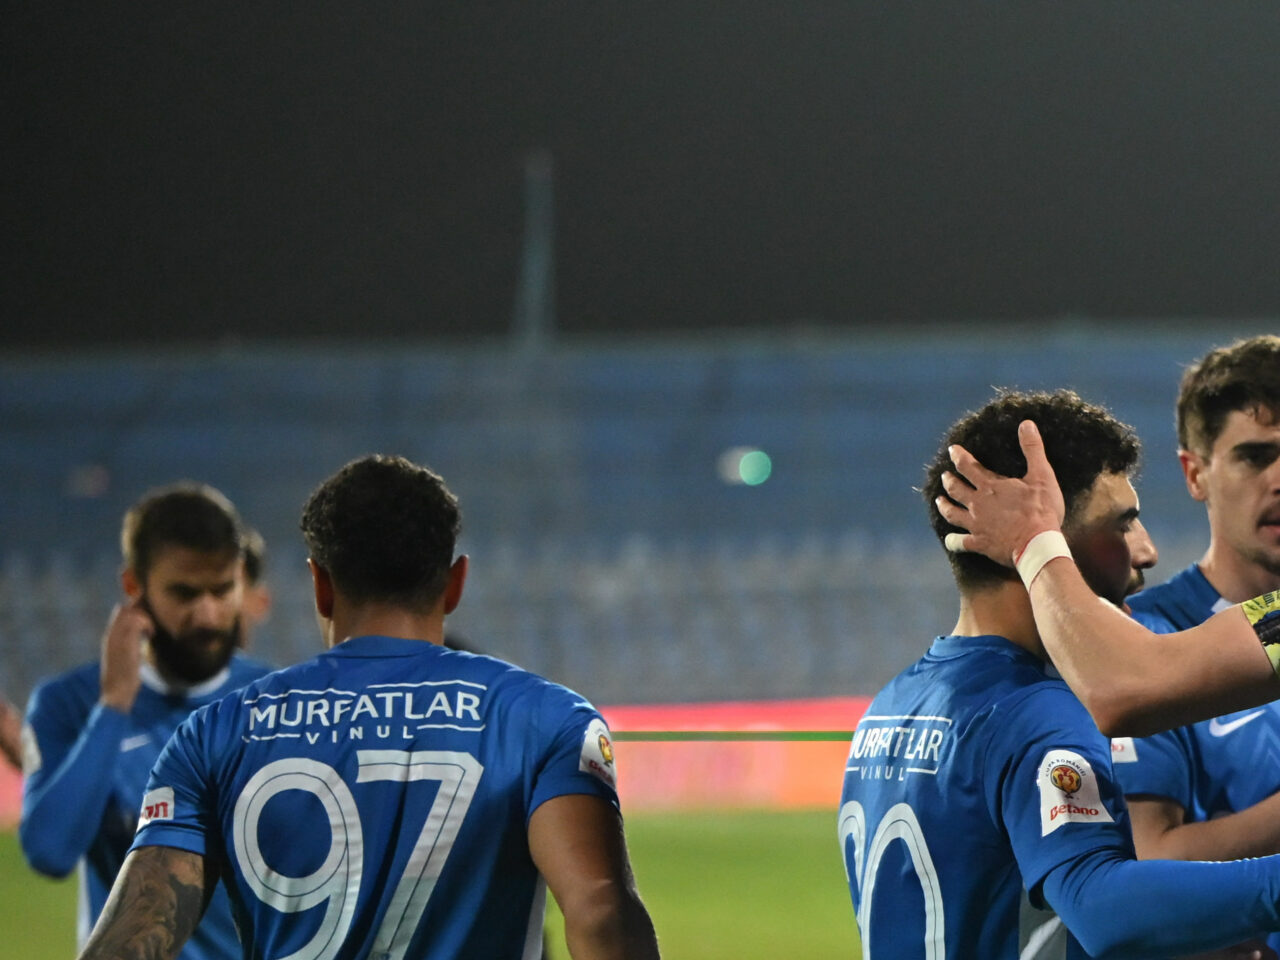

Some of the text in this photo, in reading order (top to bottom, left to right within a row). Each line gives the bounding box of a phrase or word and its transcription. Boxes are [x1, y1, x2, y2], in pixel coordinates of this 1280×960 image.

[250, 691, 481, 731] MURFATLAR
[306, 725, 414, 745] VINUL
[861, 766, 904, 782] VINUL
[1050, 803, 1100, 821] Betano
